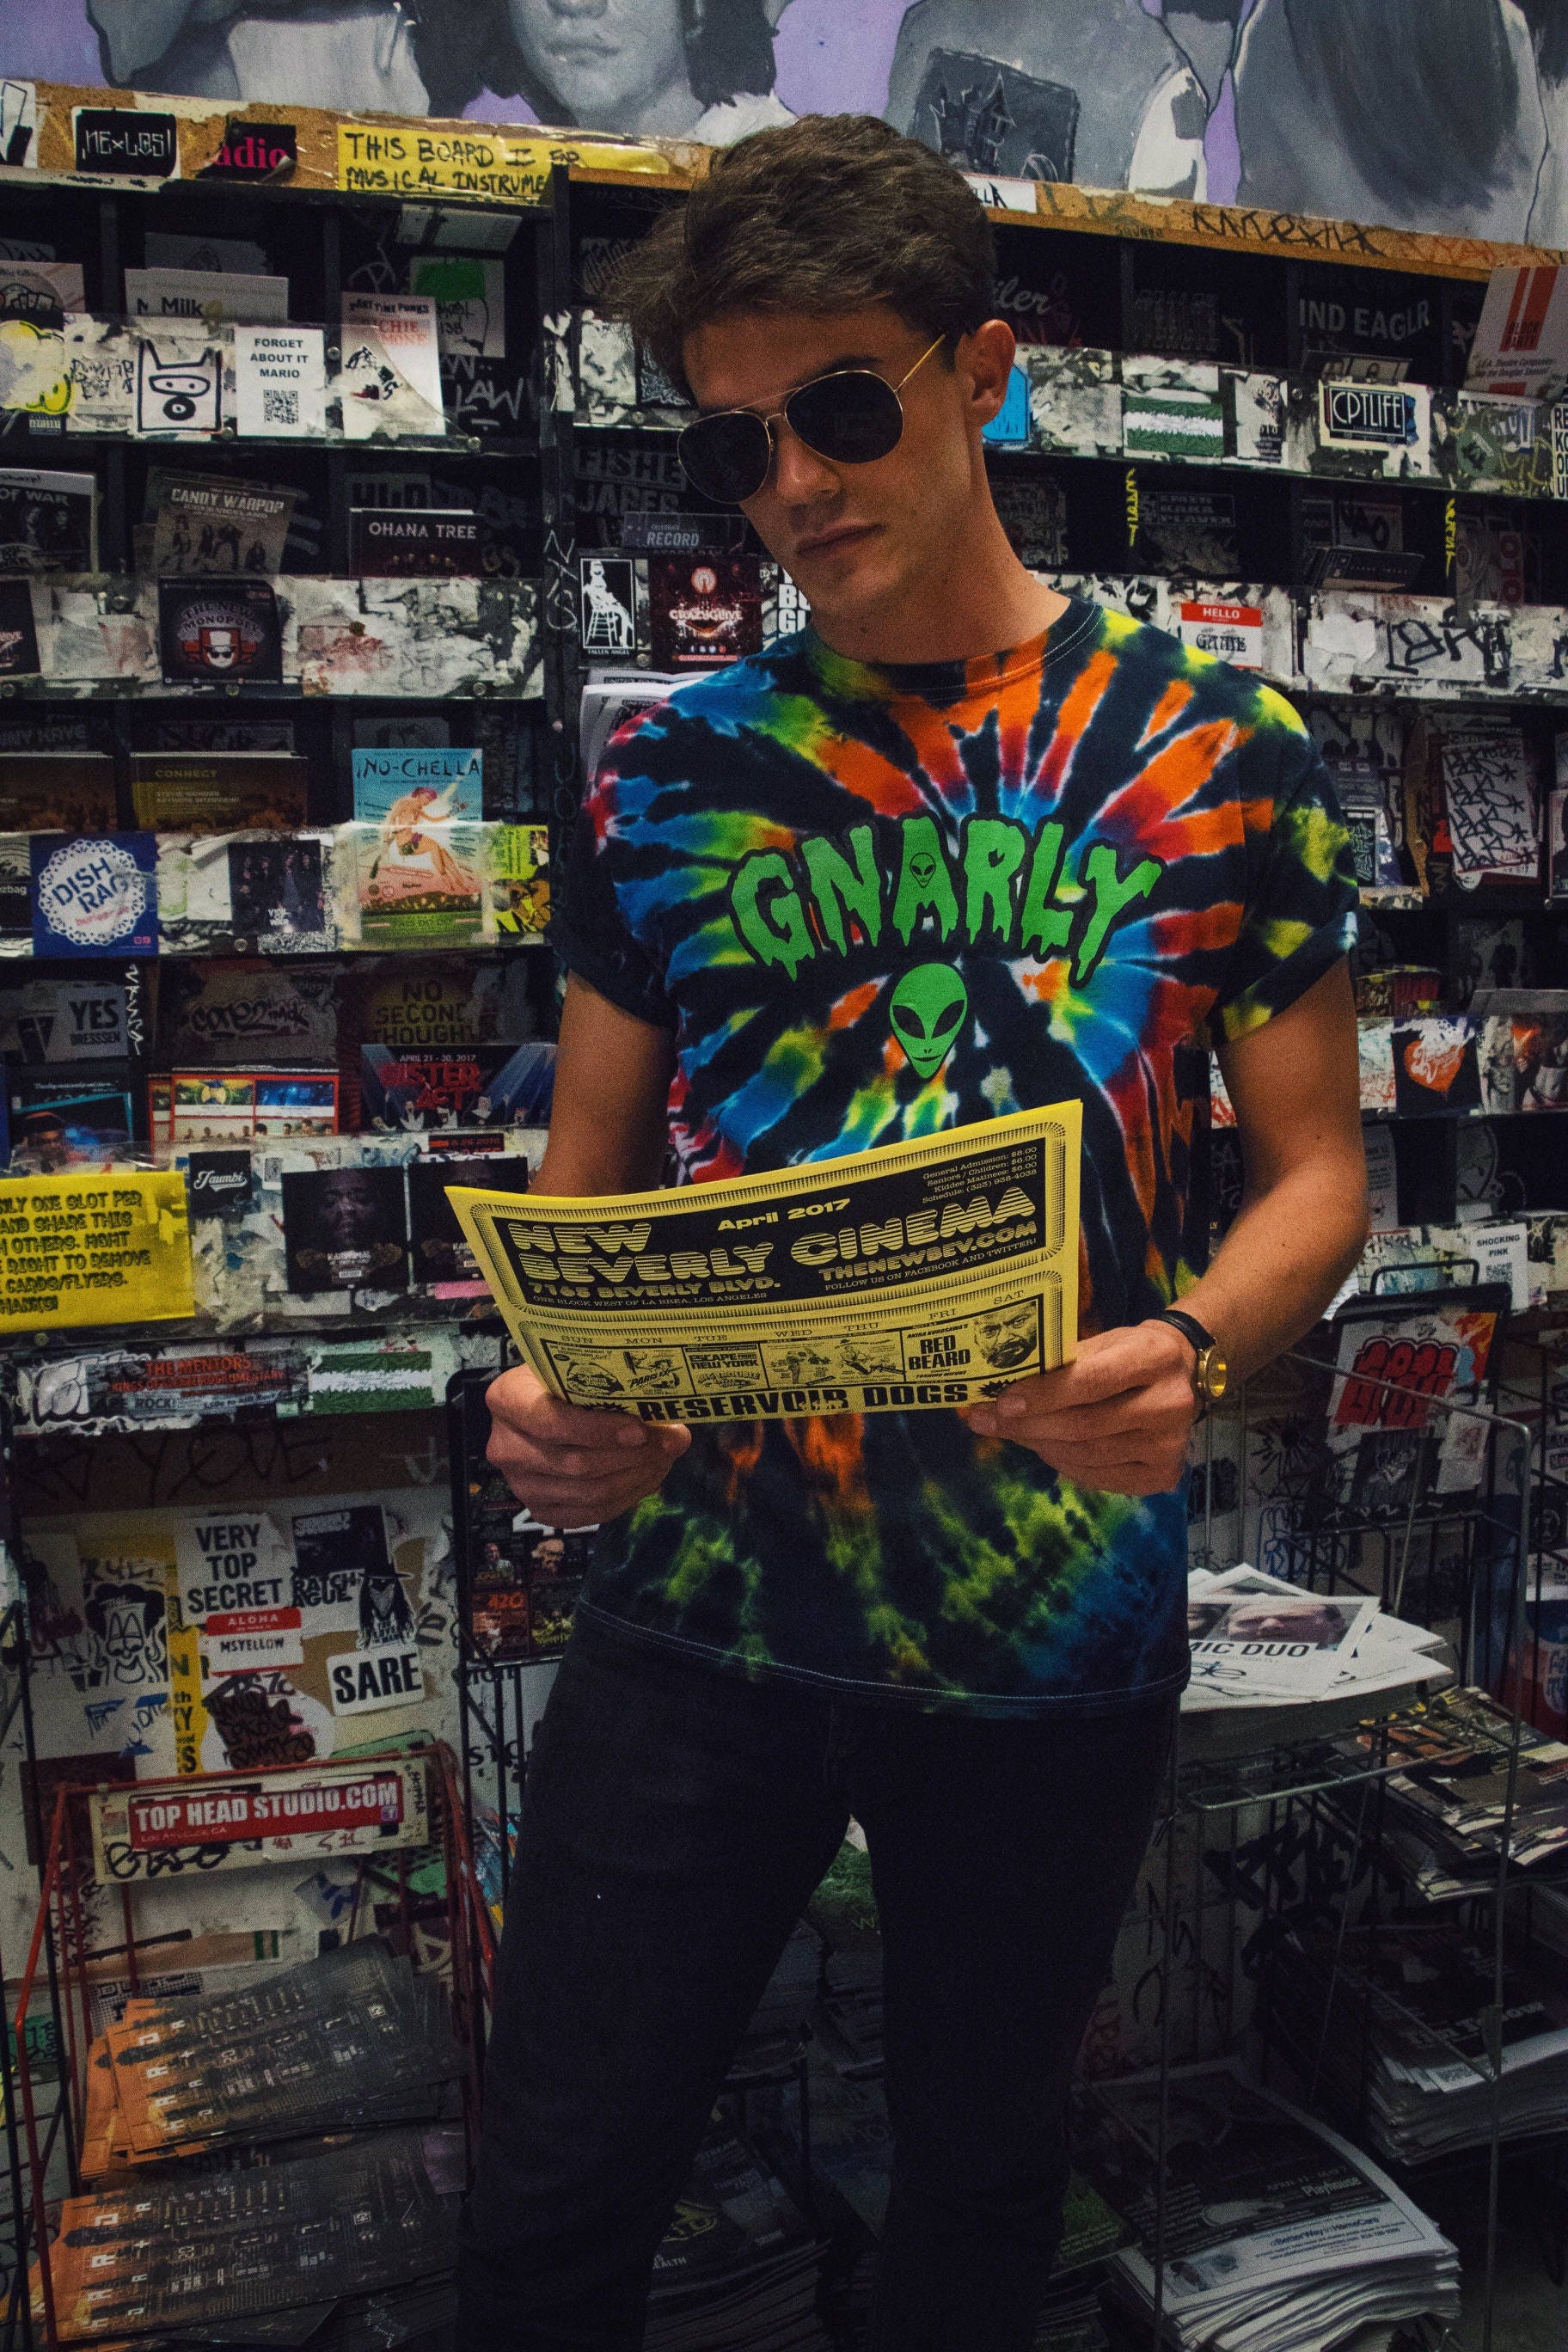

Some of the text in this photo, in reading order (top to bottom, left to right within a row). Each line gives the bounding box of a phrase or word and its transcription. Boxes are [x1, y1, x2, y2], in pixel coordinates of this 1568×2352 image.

[346, 132, 495, 167] THIS BOARD
[346, 167, 445, 191] MUSICAL
[162, 297, 203, 316] Milk
[254, 338, 303, 348] FORGET
[250, 353, 308, 363] ABOUT IT
[260, 369, 300, 378] MARIO
[172, 488, 218, 505] CANDY
[369, 522, 477, 539] OHANA TREE
[646, 532, 700, 548] RECORD
[1203, 608, 1240, 619] HELLO
[52, 857, 112, 905] DISH
[78, 873, 128, 913] RAG
[731, 816, 1162, 982] GNARLY
[402, 980, 441, 1001] NO
[68, 998, 118, 1030] YES
[399, 1055, 421, 1063] APRIL
[455, 1054, 477, 1063] 2017
[923, 1166, 958, 1179] General
[928, 1173, 961, 1186] Seniors
[32, 1190, 143, 1211] ONE SLOT PER
[34, 1213, 87, 1232] SHARE
[91, 1211, 132, 1228] THIS
[717, 1198, 850, 1230] April 2017
[508, 1222, 652, 1253] NEW
[519, 1186, 1036, 1283] BEVERLY CINEMA
[1477, 1234, 1521, 1247] SHOCKING
[7, 1249, 152, 1275] RIGHT TO REMOVE
[818, 1222, 1037, 1282] THENEWBEV.COM
[1488, 1248, 1509, 1257] PINK
[825, 1278, 867, 1290] FOLLOW
[871, 1276, 885, 1284] US
[887, 1271, 903, 1281] ON
[904, 1261, 960, 1278] FACEBOOK
[961, 1253, 984, 1265] AND
[597, 1283, 701, 1298] BEVERLY
[709, 1277, 781, 1293] BLVD.
[693, 1295, 714, 1304] LOS
[717, 1293, 768, 1302] ANGELES
[561, 1335, 593, 1344] SUN
[775, 1329, 812, 1338] WED
[844, 1322, 879, 1332] THU
[929, 1308, 956, 1320] FRI
[993, 1289, 1025, 1305] SAT
[920, 1335, 956, 1354] RED
[144, 1355, 250, 1376] THE MENTORS
[909, 1349, 971, 1370] BEARD
[637, 1384, 968, 1421] RESERVOIR DOGS
[195, 1523, 260, 1552] VERY
[205, 1553, 256, 1581] TOP
[187, 1578, 283, 1614] SECRET
[228, 1614, 279, 1626] ALOHA
[1240, 1644, 1310, 1657] DUO
[333, 1652, 422, 1705] SARE
[136, 1781, 397, 1832] TOP HEAD STUDIO.COM
[1302, 2177, 1362, 2196] Playhouse
